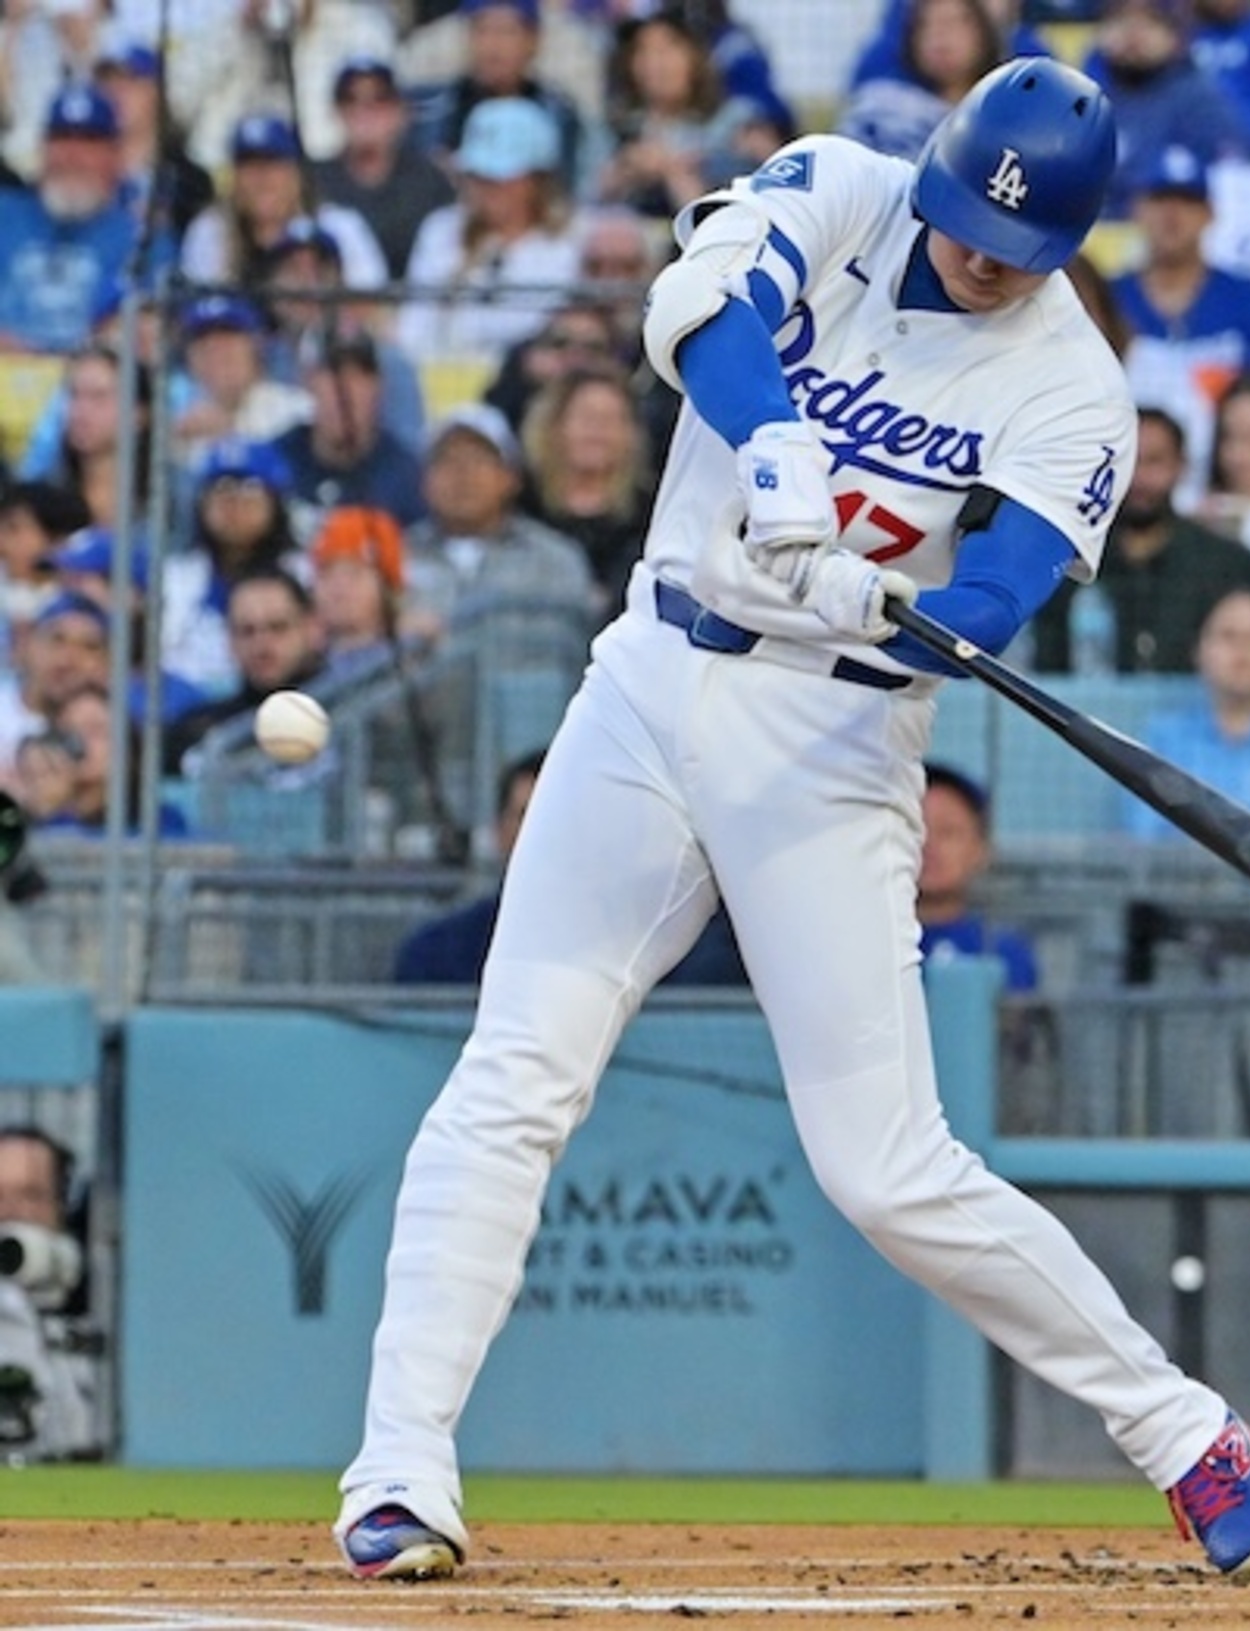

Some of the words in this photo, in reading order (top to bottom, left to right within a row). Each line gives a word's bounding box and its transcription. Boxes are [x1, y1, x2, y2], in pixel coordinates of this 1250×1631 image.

[987, 148, 1028, 209] LA
[1077, 445, 1115, 527] LA
[623, 1239, 797, 1274] CASINO
[513, 1284, 554, 1311] N
[571, 1280, 753, 1316] MANUEL
